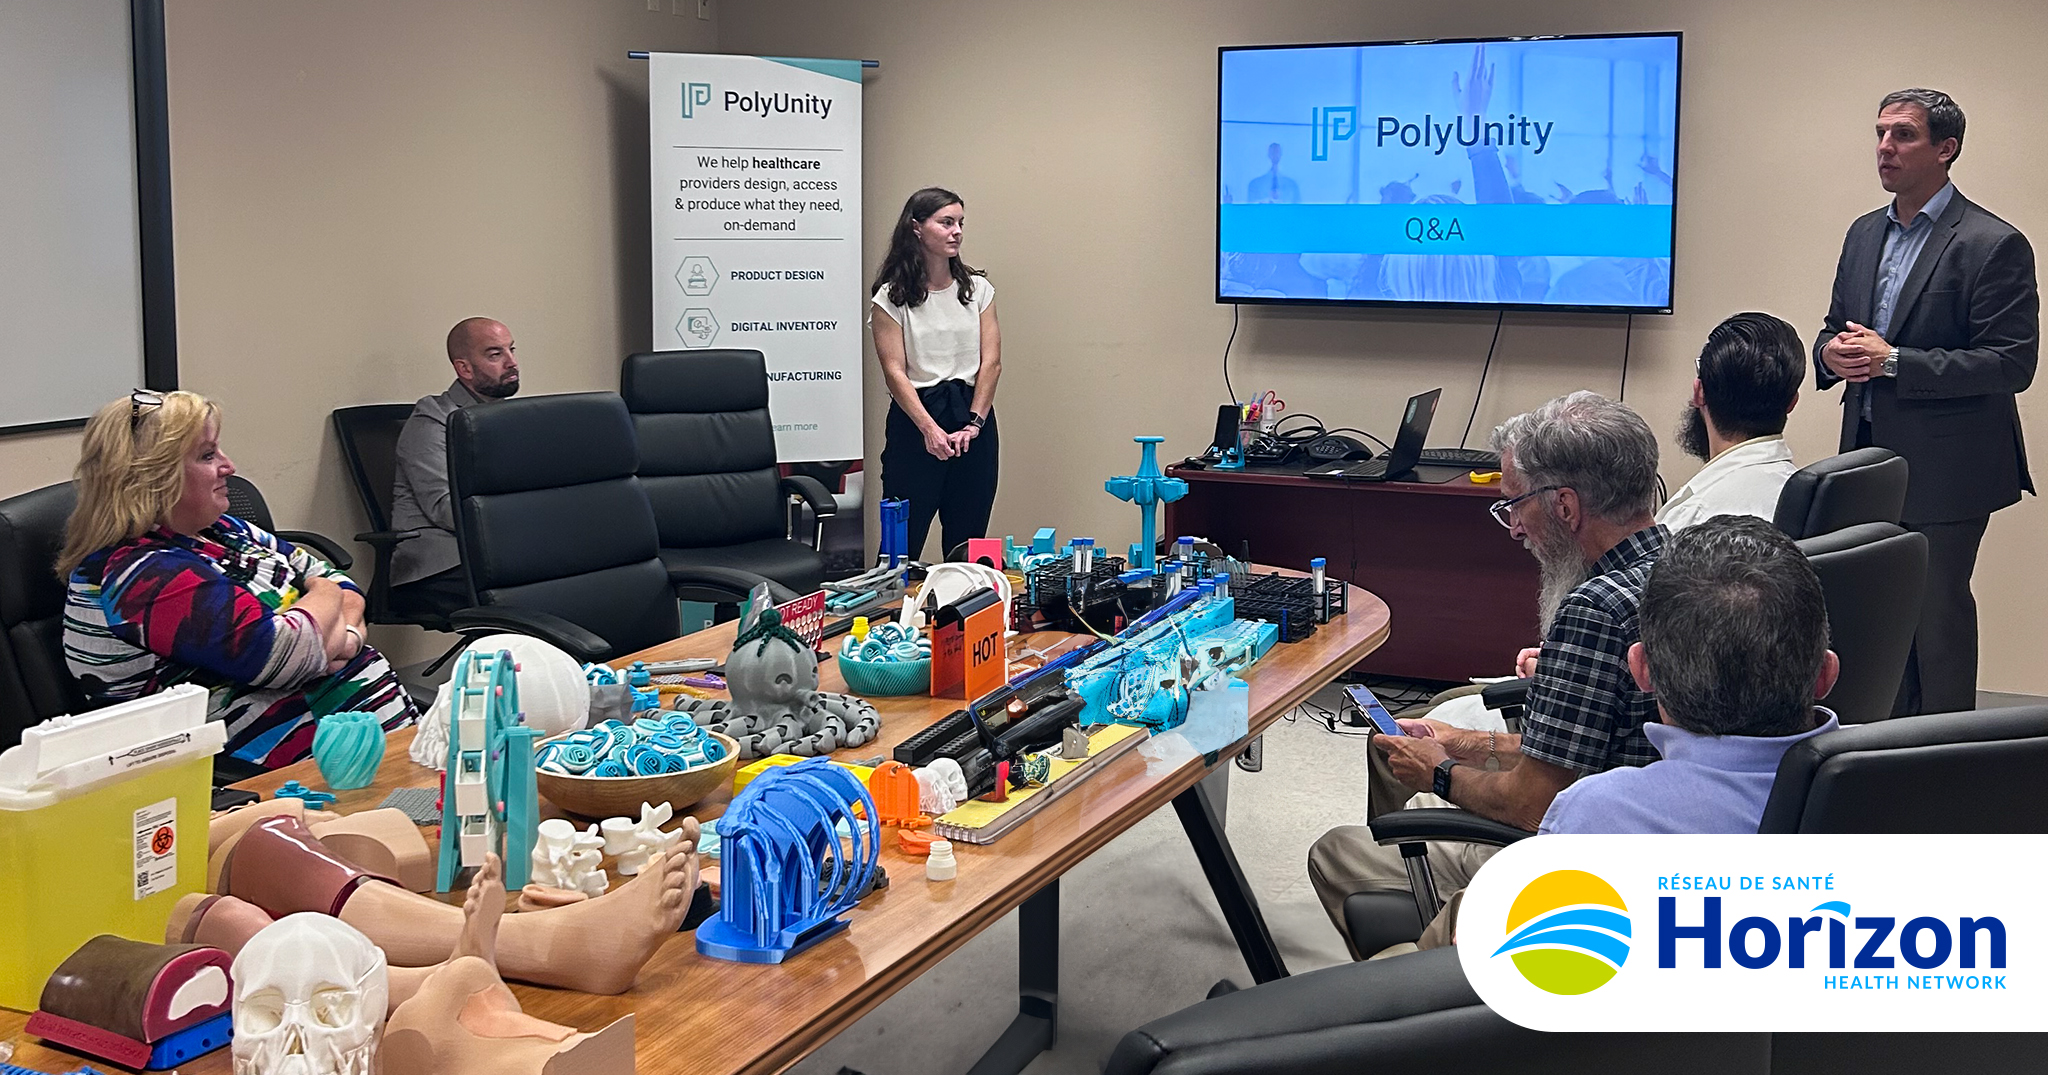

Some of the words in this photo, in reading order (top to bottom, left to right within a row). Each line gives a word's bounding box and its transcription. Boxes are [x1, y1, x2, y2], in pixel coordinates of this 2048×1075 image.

[724, 91, 833, 119] PolyUnity
[1377, 113, 1554, 155] PolyUnity
[697, 156, 718, 168] We
[722, 156, 749, 171] help
[752, 156, 821, 170] healthcare
[680, 177, 740, 191] providers
[744, 178, 790, 193] design,
[793, 180, 838, 191] access
[675, 198, 684, 210] &
[688, 198, 741, 212] produce
[744, 198, 775, 210] what
[778, 198, 806, 214] they
[809, 199, 843, 213] need,
[723, 219, 796, 231] on-demand
[1405, 217, 1465, 244] Q&A
[730, 270, 782, 281] PRODUCT
[785, 270, 825, 280] DESIGN
[731, 322, 774, 332] DIGITAL
[776, 321, 838, 331] INVENTORY
[766, 371, 842, 382] NUFACTURING
[773, 424, 792, 432] earn
[794, 423, 818, 431] more
[792, 596, 818, 615] READY
[973, 631, 998, 668] HOT
